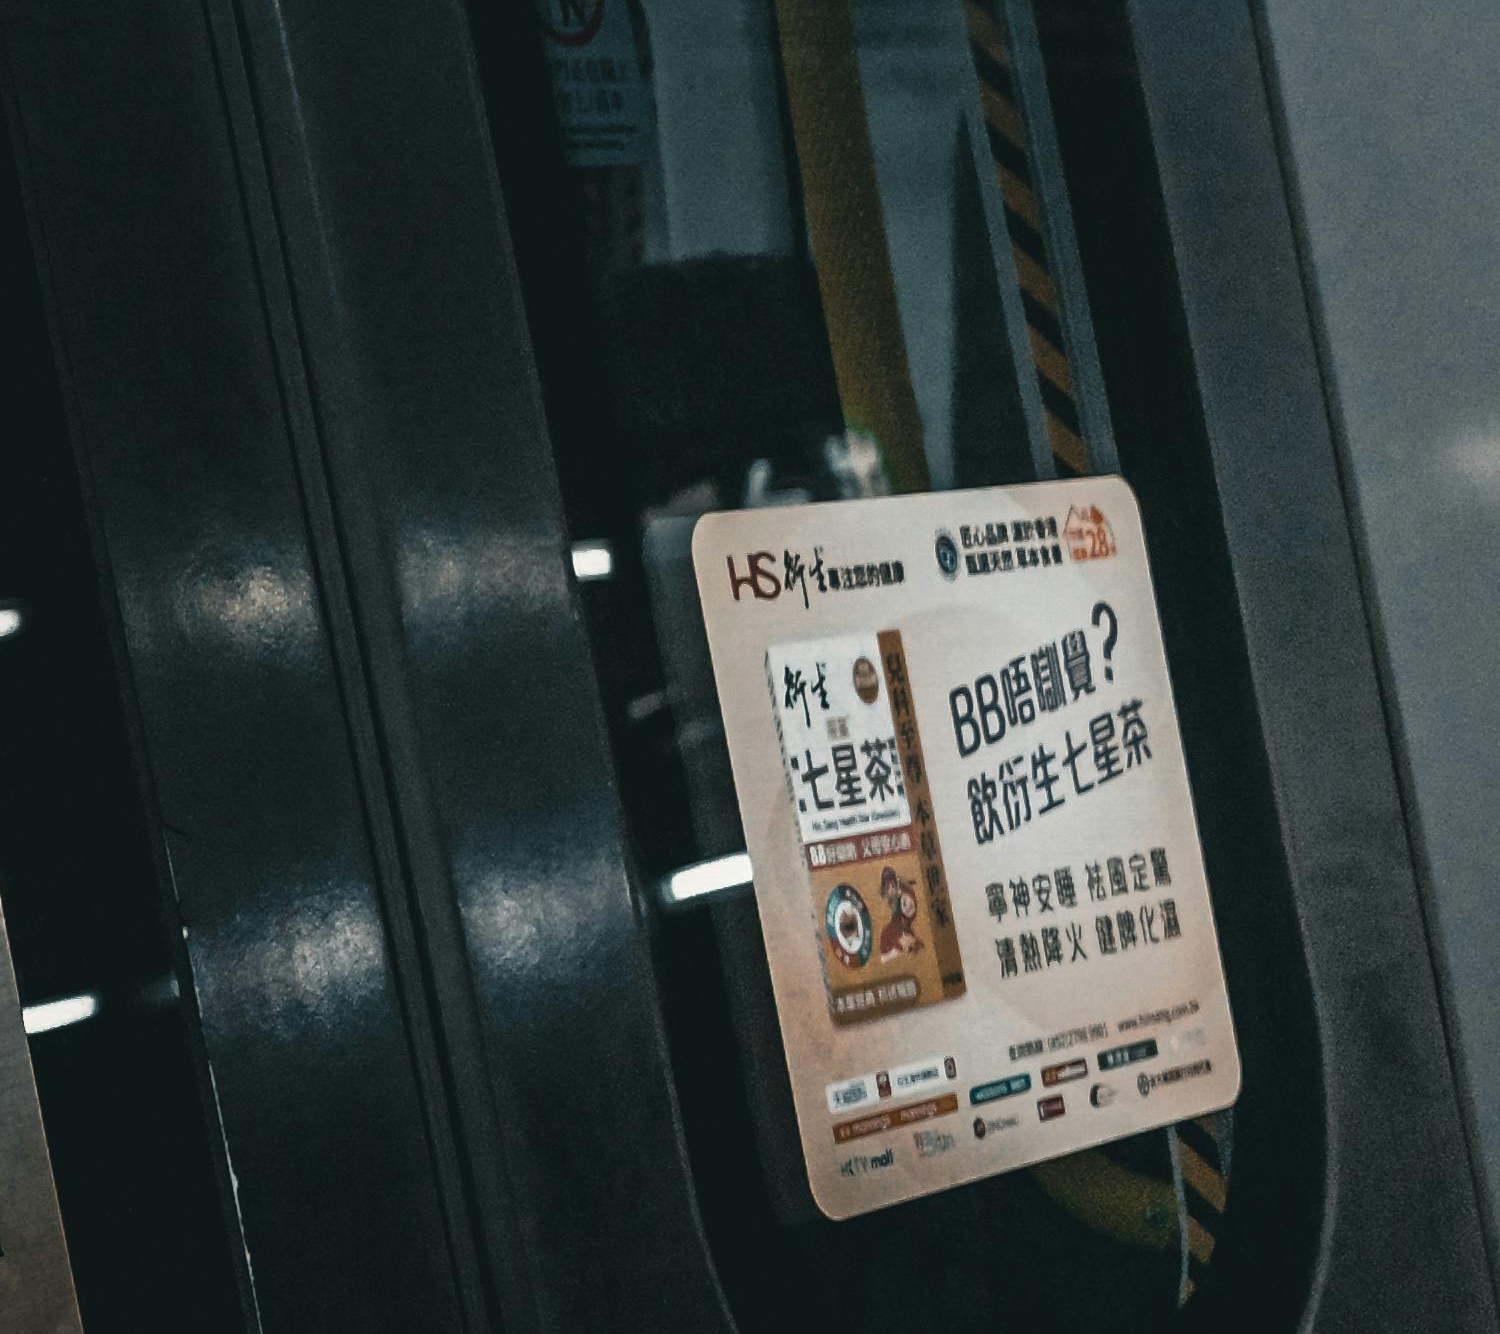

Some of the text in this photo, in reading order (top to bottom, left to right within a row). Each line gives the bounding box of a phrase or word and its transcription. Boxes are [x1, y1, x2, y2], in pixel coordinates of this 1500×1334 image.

[727, 552, 782, 600] HS
[801, 737, 896, 811] 七星茶
[967, 699, 1153, 845] 飲衍生七星茶
